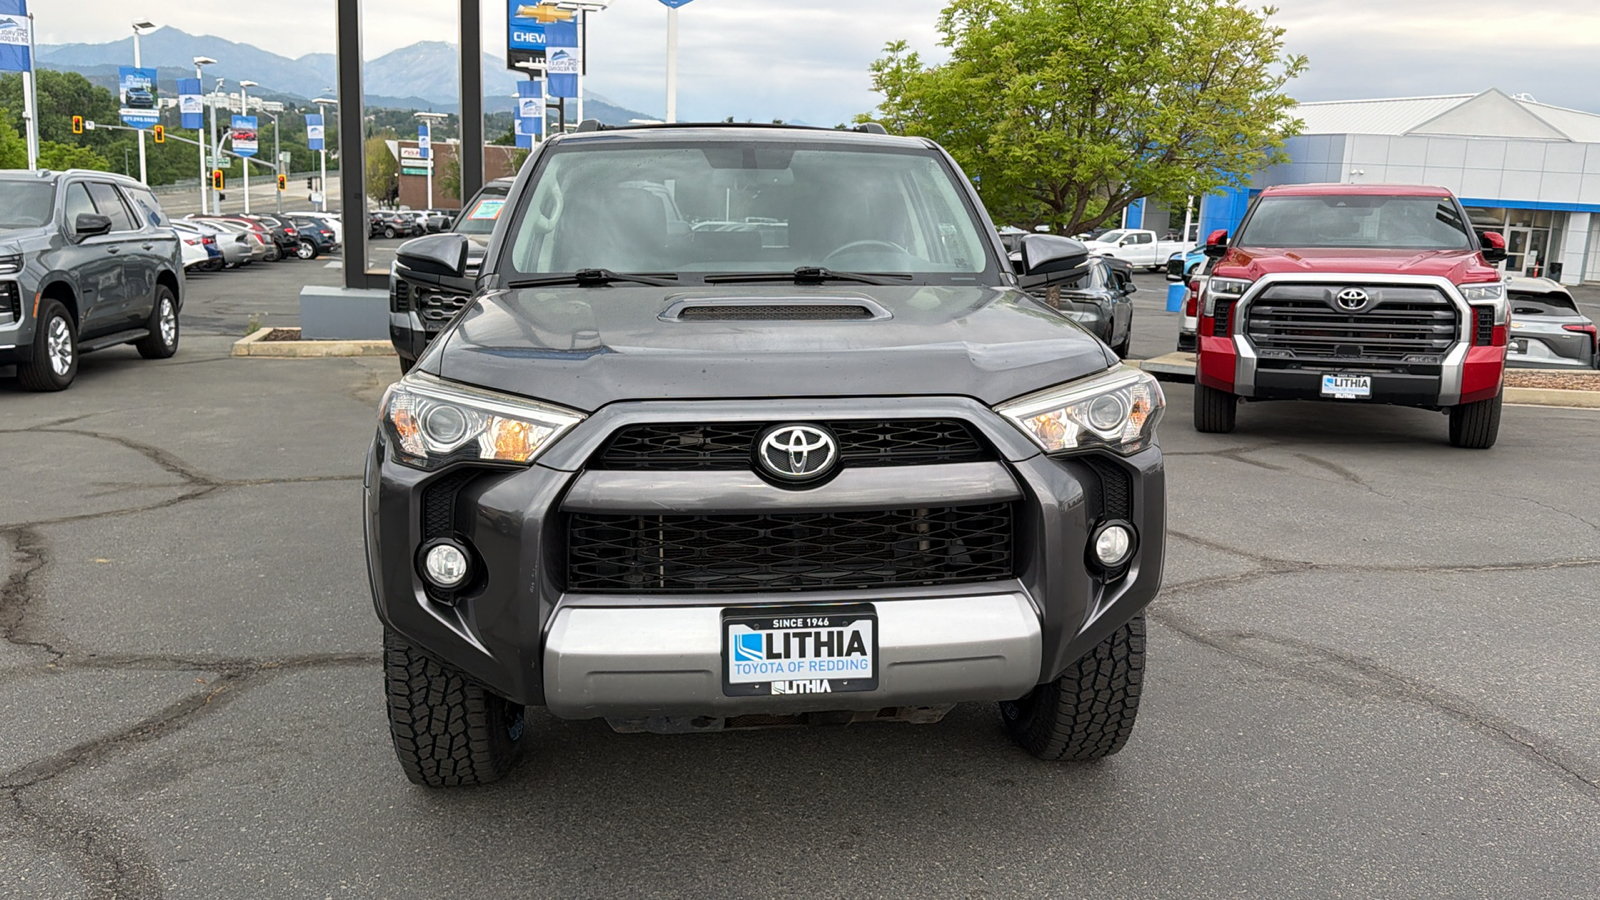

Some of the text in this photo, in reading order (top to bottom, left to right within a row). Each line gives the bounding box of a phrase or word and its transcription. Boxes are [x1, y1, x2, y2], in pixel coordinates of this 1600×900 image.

[513, 31, 546, 43] CHEV
[1334, 378, 1368, 388] LITHIA
[773, 618, 829, 628] SINCE 1946
[765, 630, 868, 660] LITHIA
[734, 659, 868, 675] TOYOTA OF REDDING
[785, 679, 832, 694] LITHIA
